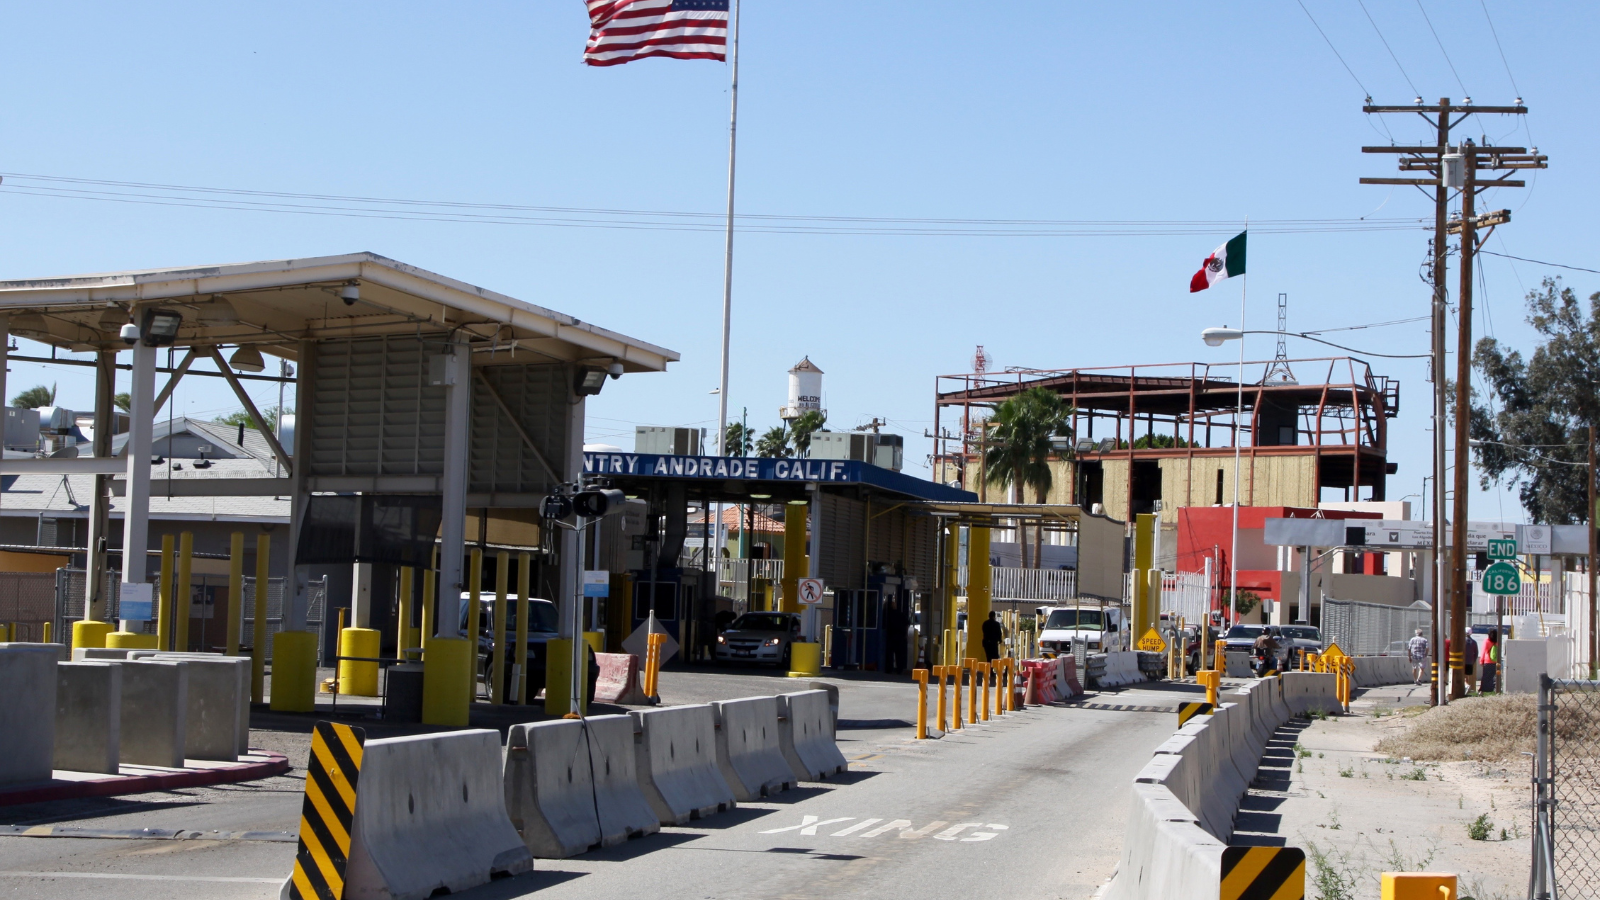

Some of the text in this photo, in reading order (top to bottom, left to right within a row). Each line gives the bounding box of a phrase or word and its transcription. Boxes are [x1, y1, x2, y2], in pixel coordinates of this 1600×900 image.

[654, 456, 759, 478] ANDRADE
[775, 460, 847, 480] CALIF.
[1489, 542, 1515, 557] END
[1486, 574, 1518, 591] 186
[758, 815, 1009, 842] XING
